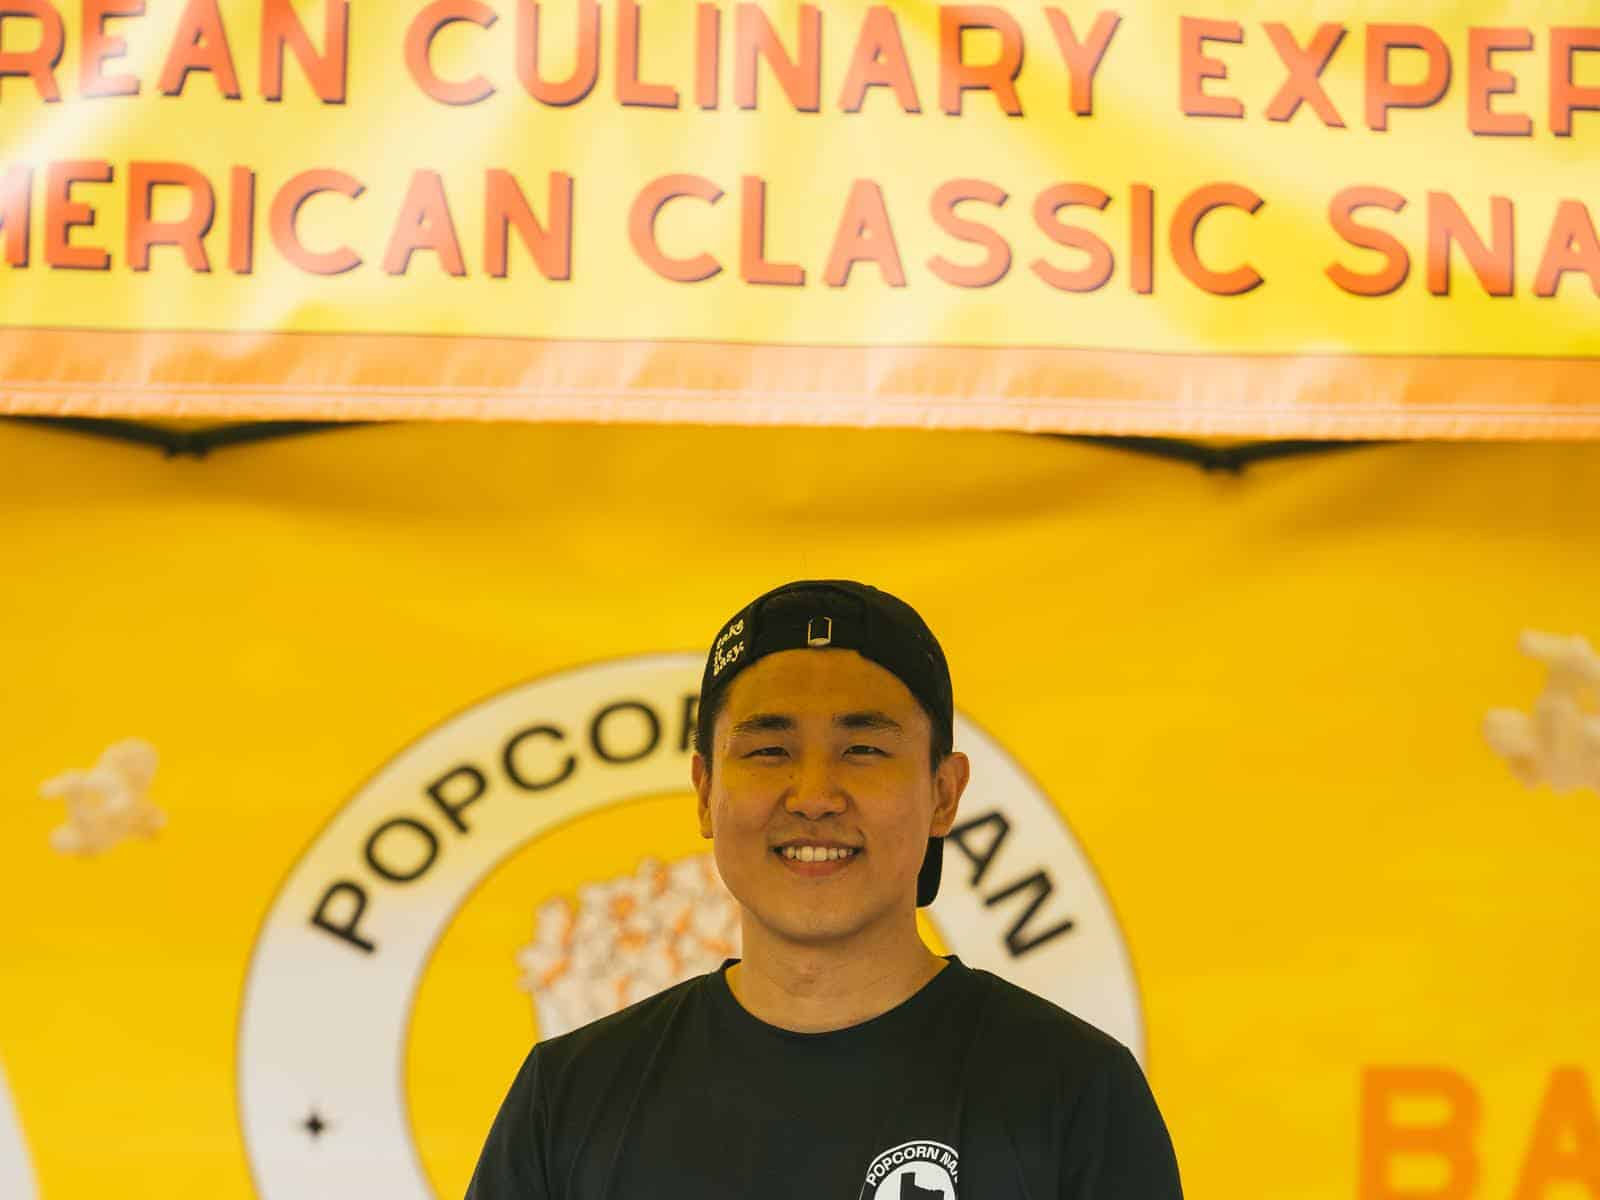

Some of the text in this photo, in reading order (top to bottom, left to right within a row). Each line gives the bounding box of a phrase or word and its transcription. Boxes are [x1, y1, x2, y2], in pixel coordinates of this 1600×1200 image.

[403, 0, 1122, 117] CULINARY
[627, 172, 1266, 296] CLASSIC
[1324, 186, 1600, 297] SNA
[866, 1146, 940, 1187] POPCORN
